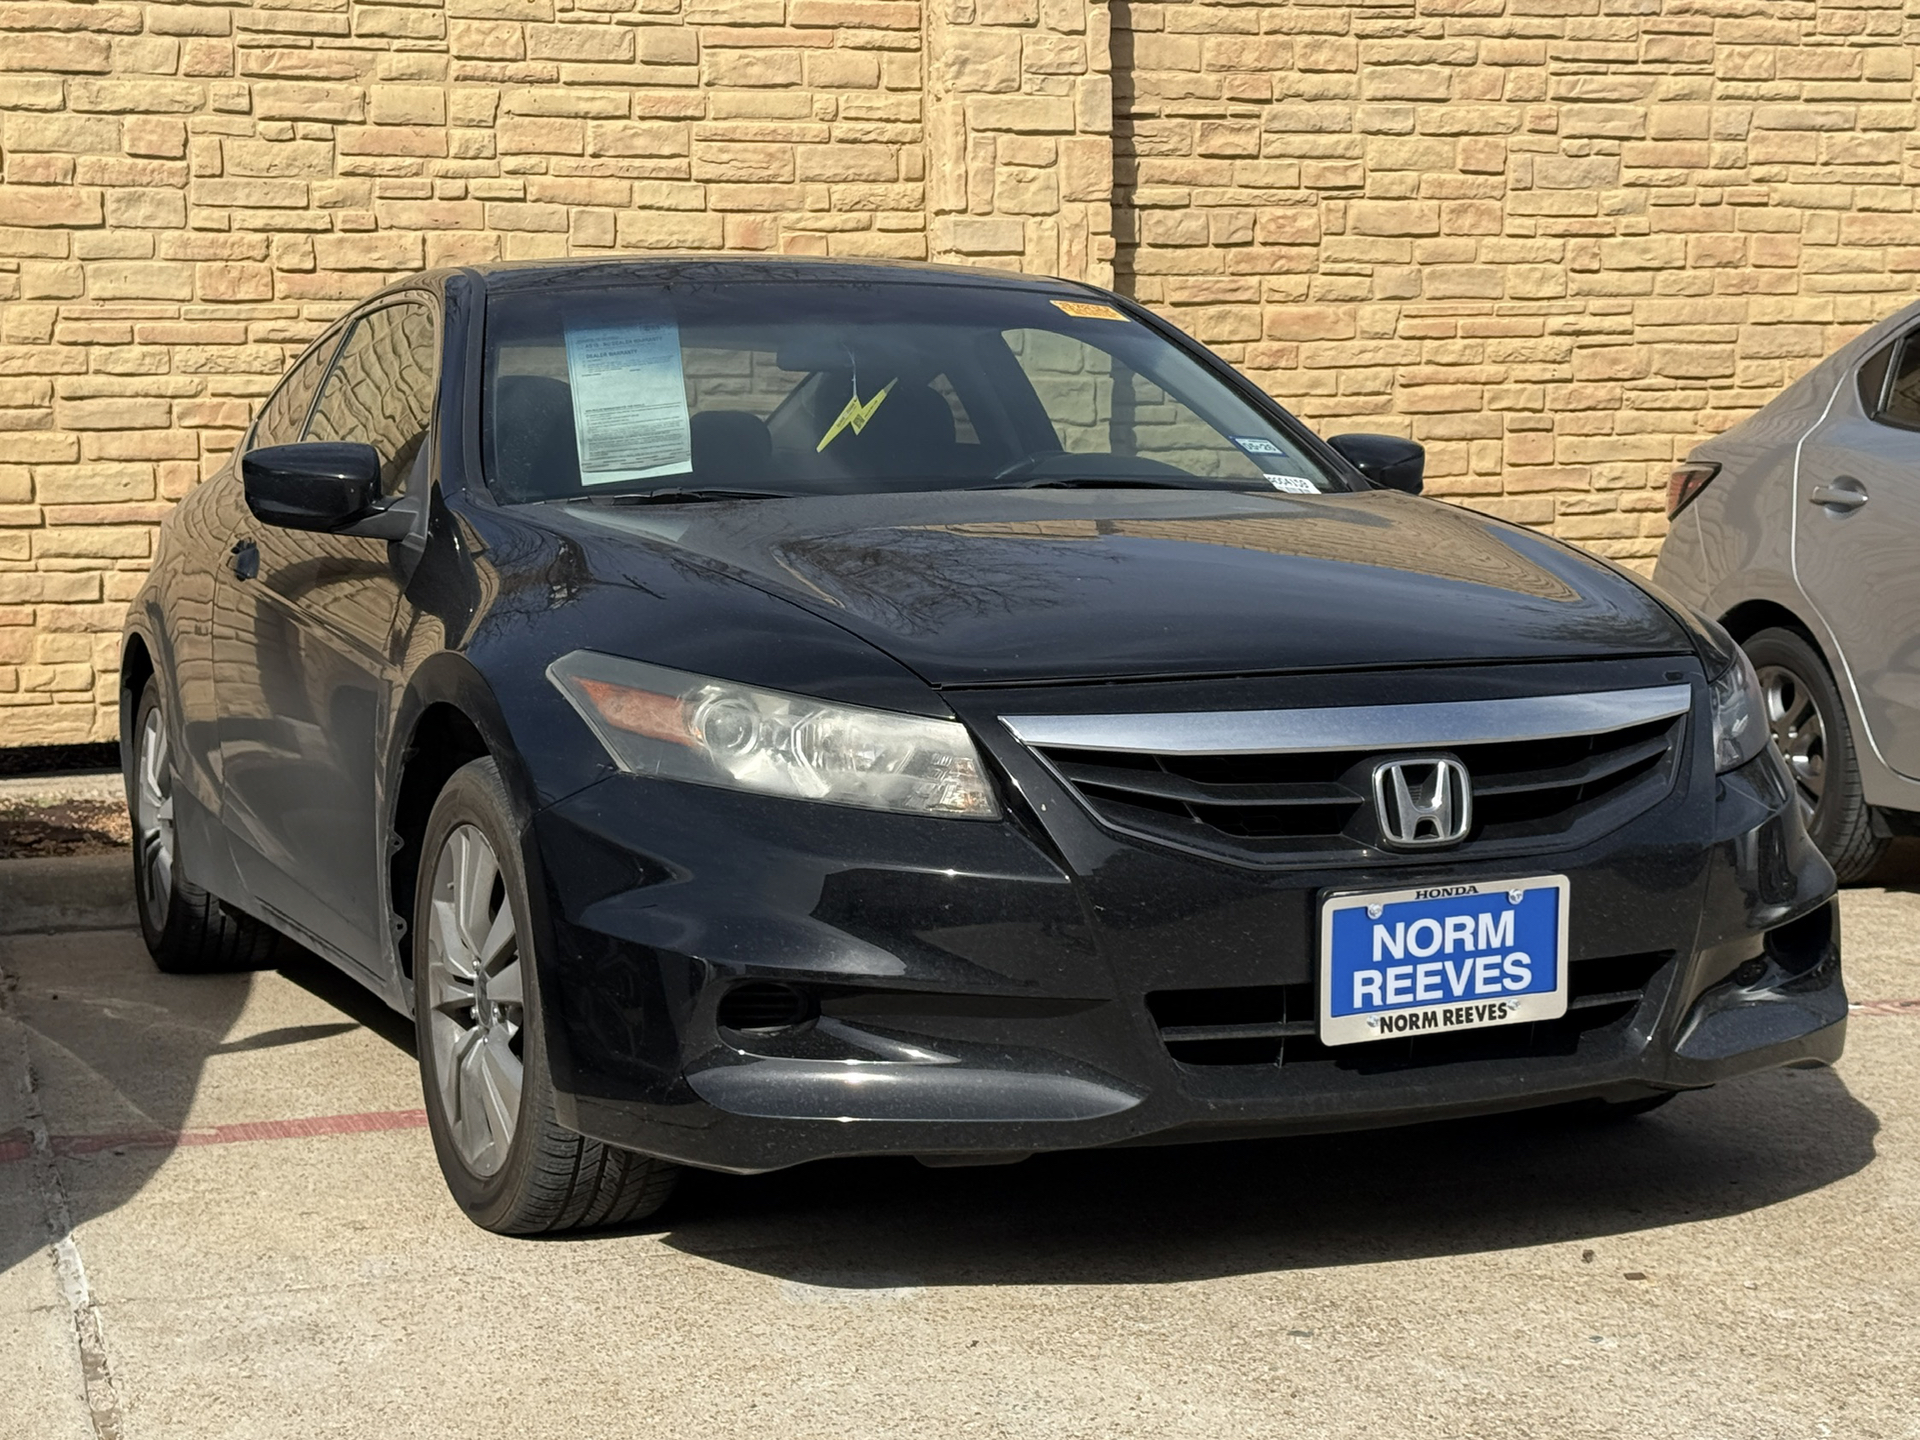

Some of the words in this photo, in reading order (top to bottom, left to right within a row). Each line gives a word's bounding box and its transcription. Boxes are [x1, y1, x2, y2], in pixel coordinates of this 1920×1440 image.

[1415, 885, 1479, 900] HONDA
[1373, 909, 1515, 962] NORM
[1353, 951, 1533, 1009] REEVES
[1380, 1010, 1439, 1034] NORM
[1443, 1002, 1508, 1026] REEVES
